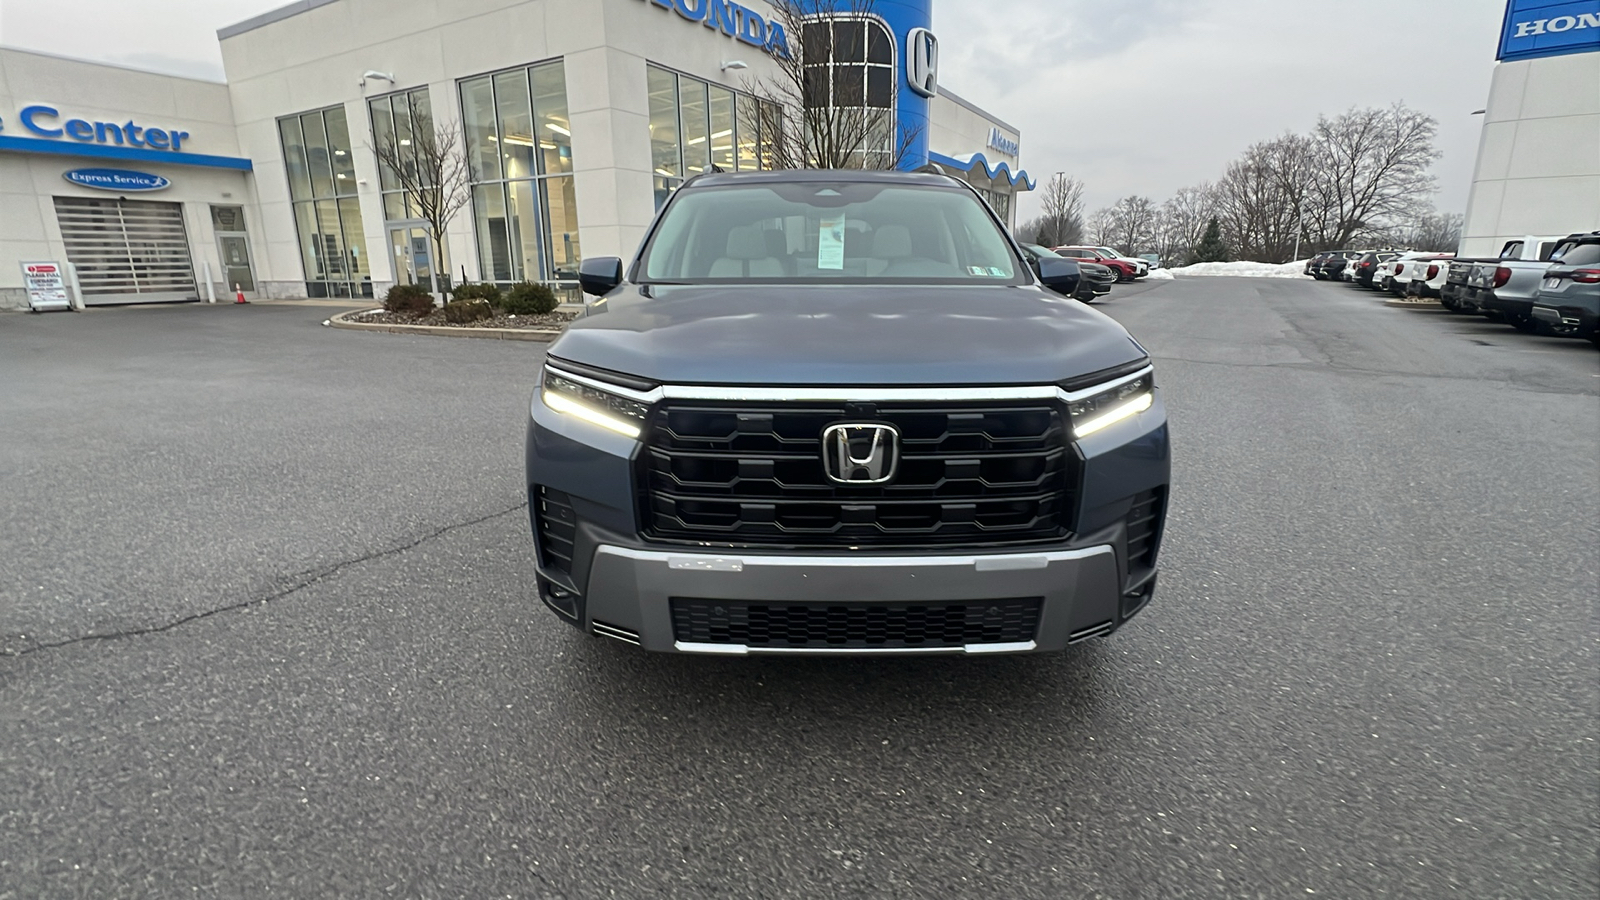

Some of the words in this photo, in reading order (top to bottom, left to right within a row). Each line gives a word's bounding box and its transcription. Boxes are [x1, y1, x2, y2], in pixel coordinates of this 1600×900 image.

[640, 0, 793, 61] ONDA
[20, 105, 190, 151] Center
[71, 172, 112, 183] Express
[113, 174, 150, 185] Service
